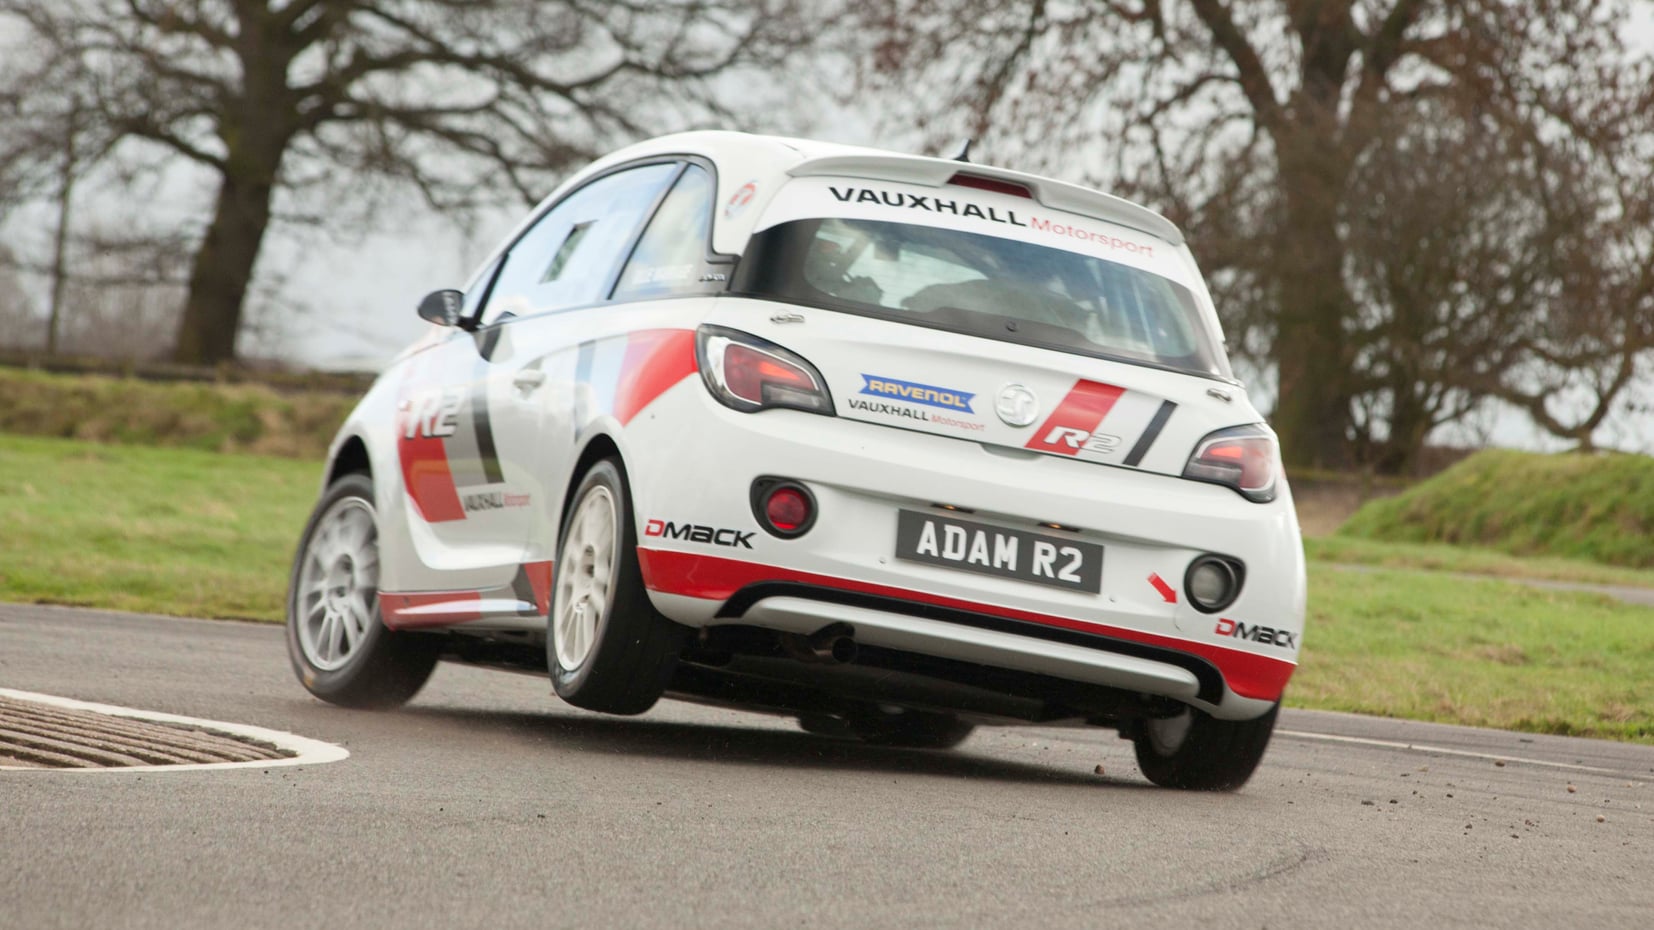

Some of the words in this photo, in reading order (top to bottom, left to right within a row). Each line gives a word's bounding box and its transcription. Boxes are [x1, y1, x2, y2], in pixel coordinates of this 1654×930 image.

[829, 186, 1026, 227] VAUXHALL
[1030, 217, 1153, 258] Motorsport
[869, 379, 966, 407] RAVENOL
[848, 398, 929, 421] VAUXHALL
[931, 413, 985, 432] Motorsport
[1043, 426, 1122, 454] R2
[916, 520, 1019, 572] ADAM
[1032, 540, 1083, 583] R2
